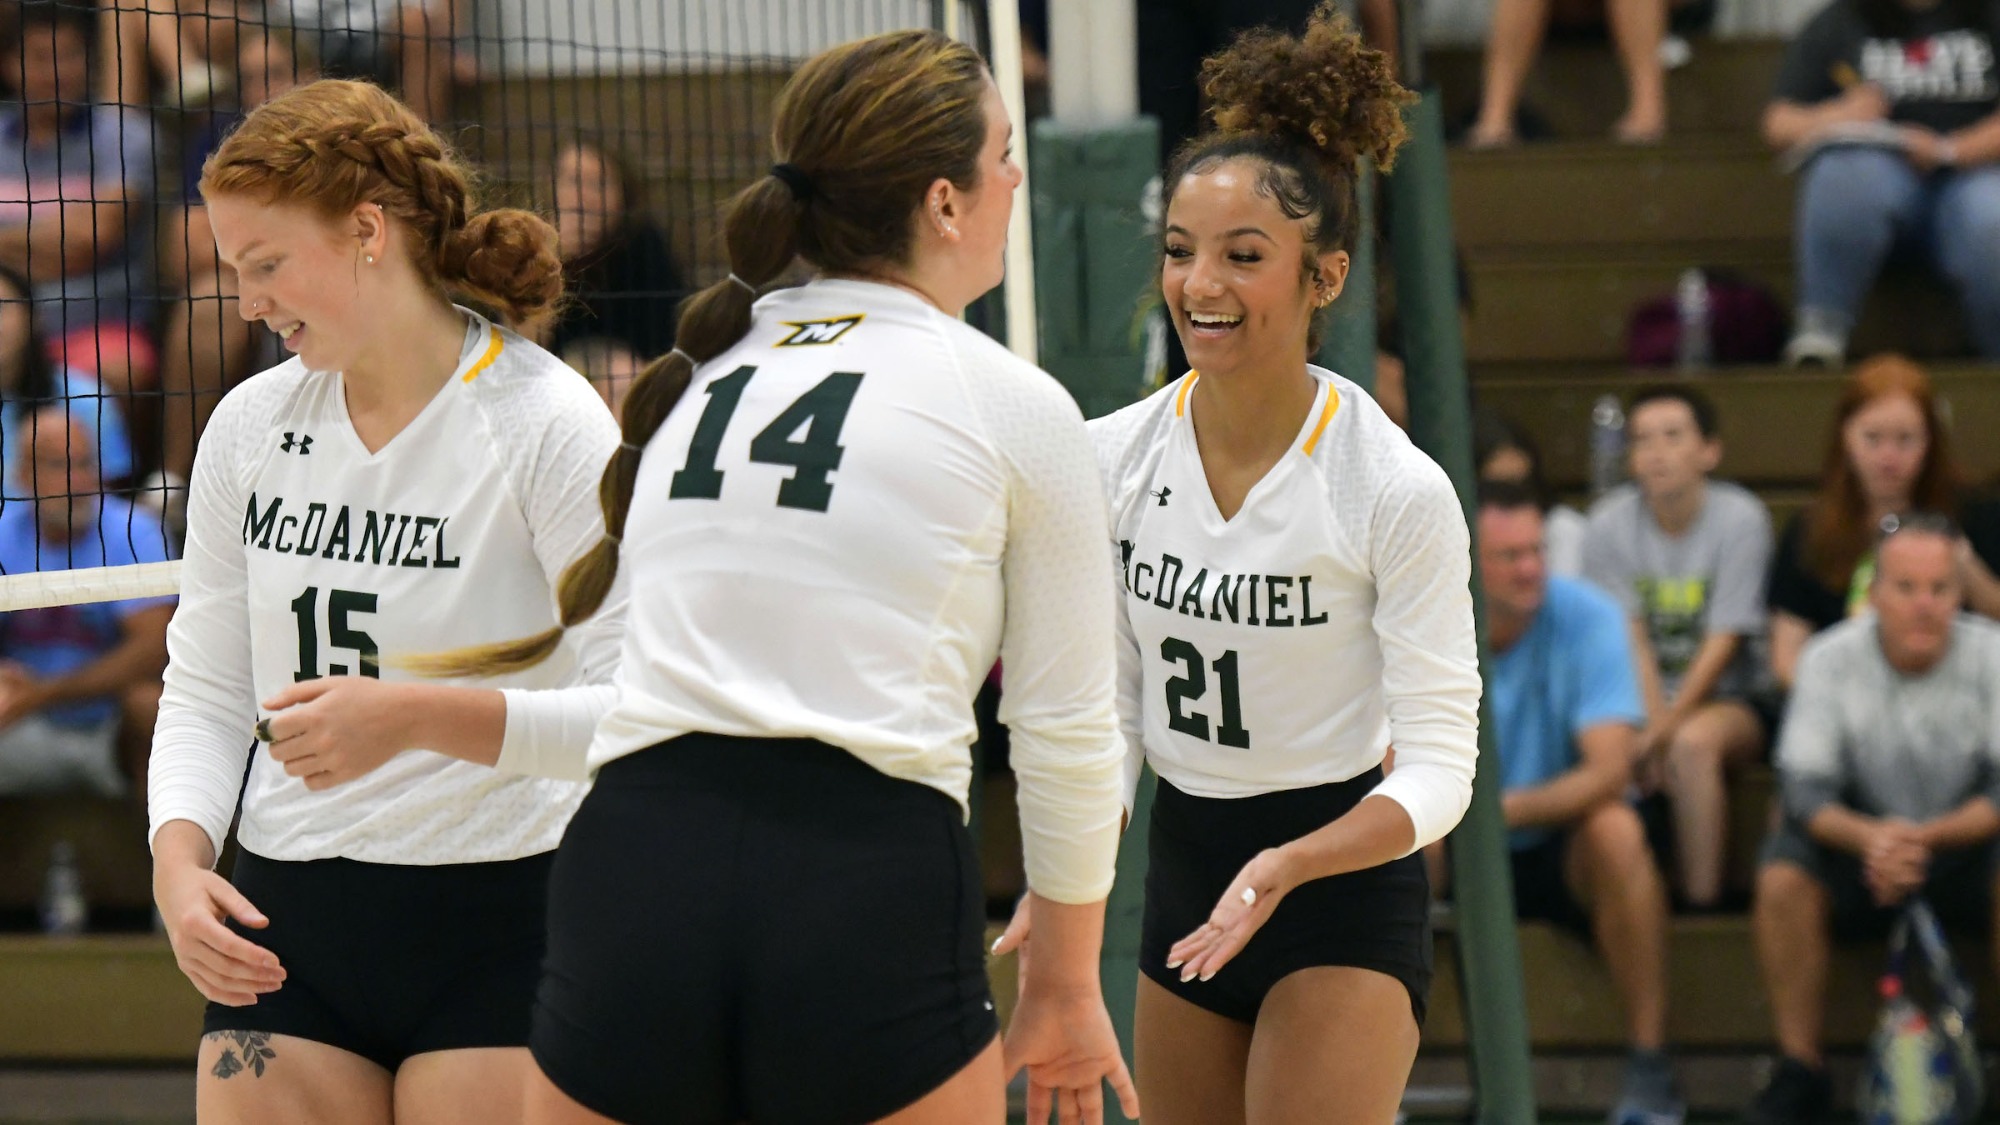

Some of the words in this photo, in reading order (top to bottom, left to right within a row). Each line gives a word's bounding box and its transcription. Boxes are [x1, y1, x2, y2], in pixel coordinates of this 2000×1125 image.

[778, 317, 862, 346] M
[669, 364, 866, 514] 14
[291, 586, 380, 683] 15
[1160, 636, 1250, 749] 21
